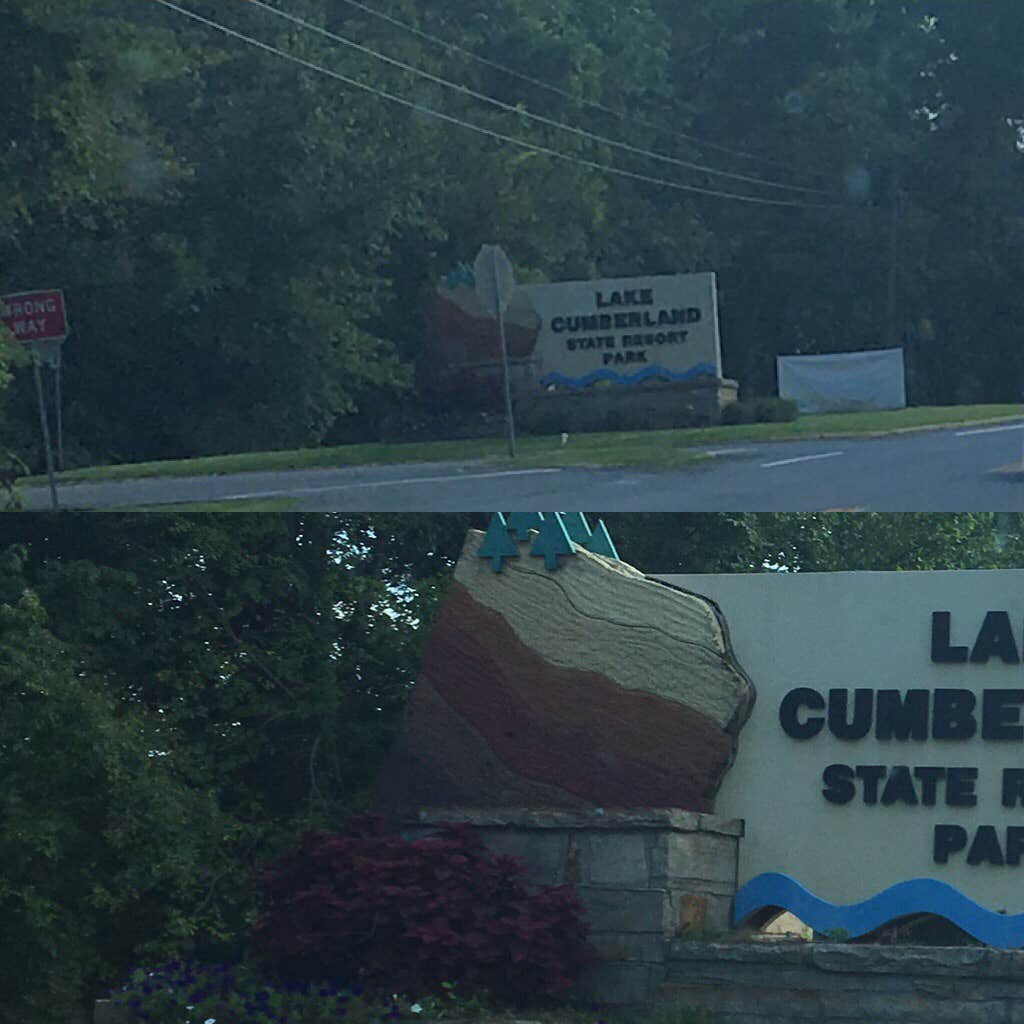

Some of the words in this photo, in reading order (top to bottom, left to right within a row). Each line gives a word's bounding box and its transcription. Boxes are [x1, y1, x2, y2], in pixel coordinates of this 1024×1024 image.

[595, 289, 654, 308] LAKE
[14, 317, 47, 335] WAY
[551, 307, 702, 333] CUMBERLAND
[566, 335, 616, 351] STATE
[622, 330, 688, 348] RESORT
[603, 350, 648, 365] PARK
[821, 763, 978, 808] STATE
